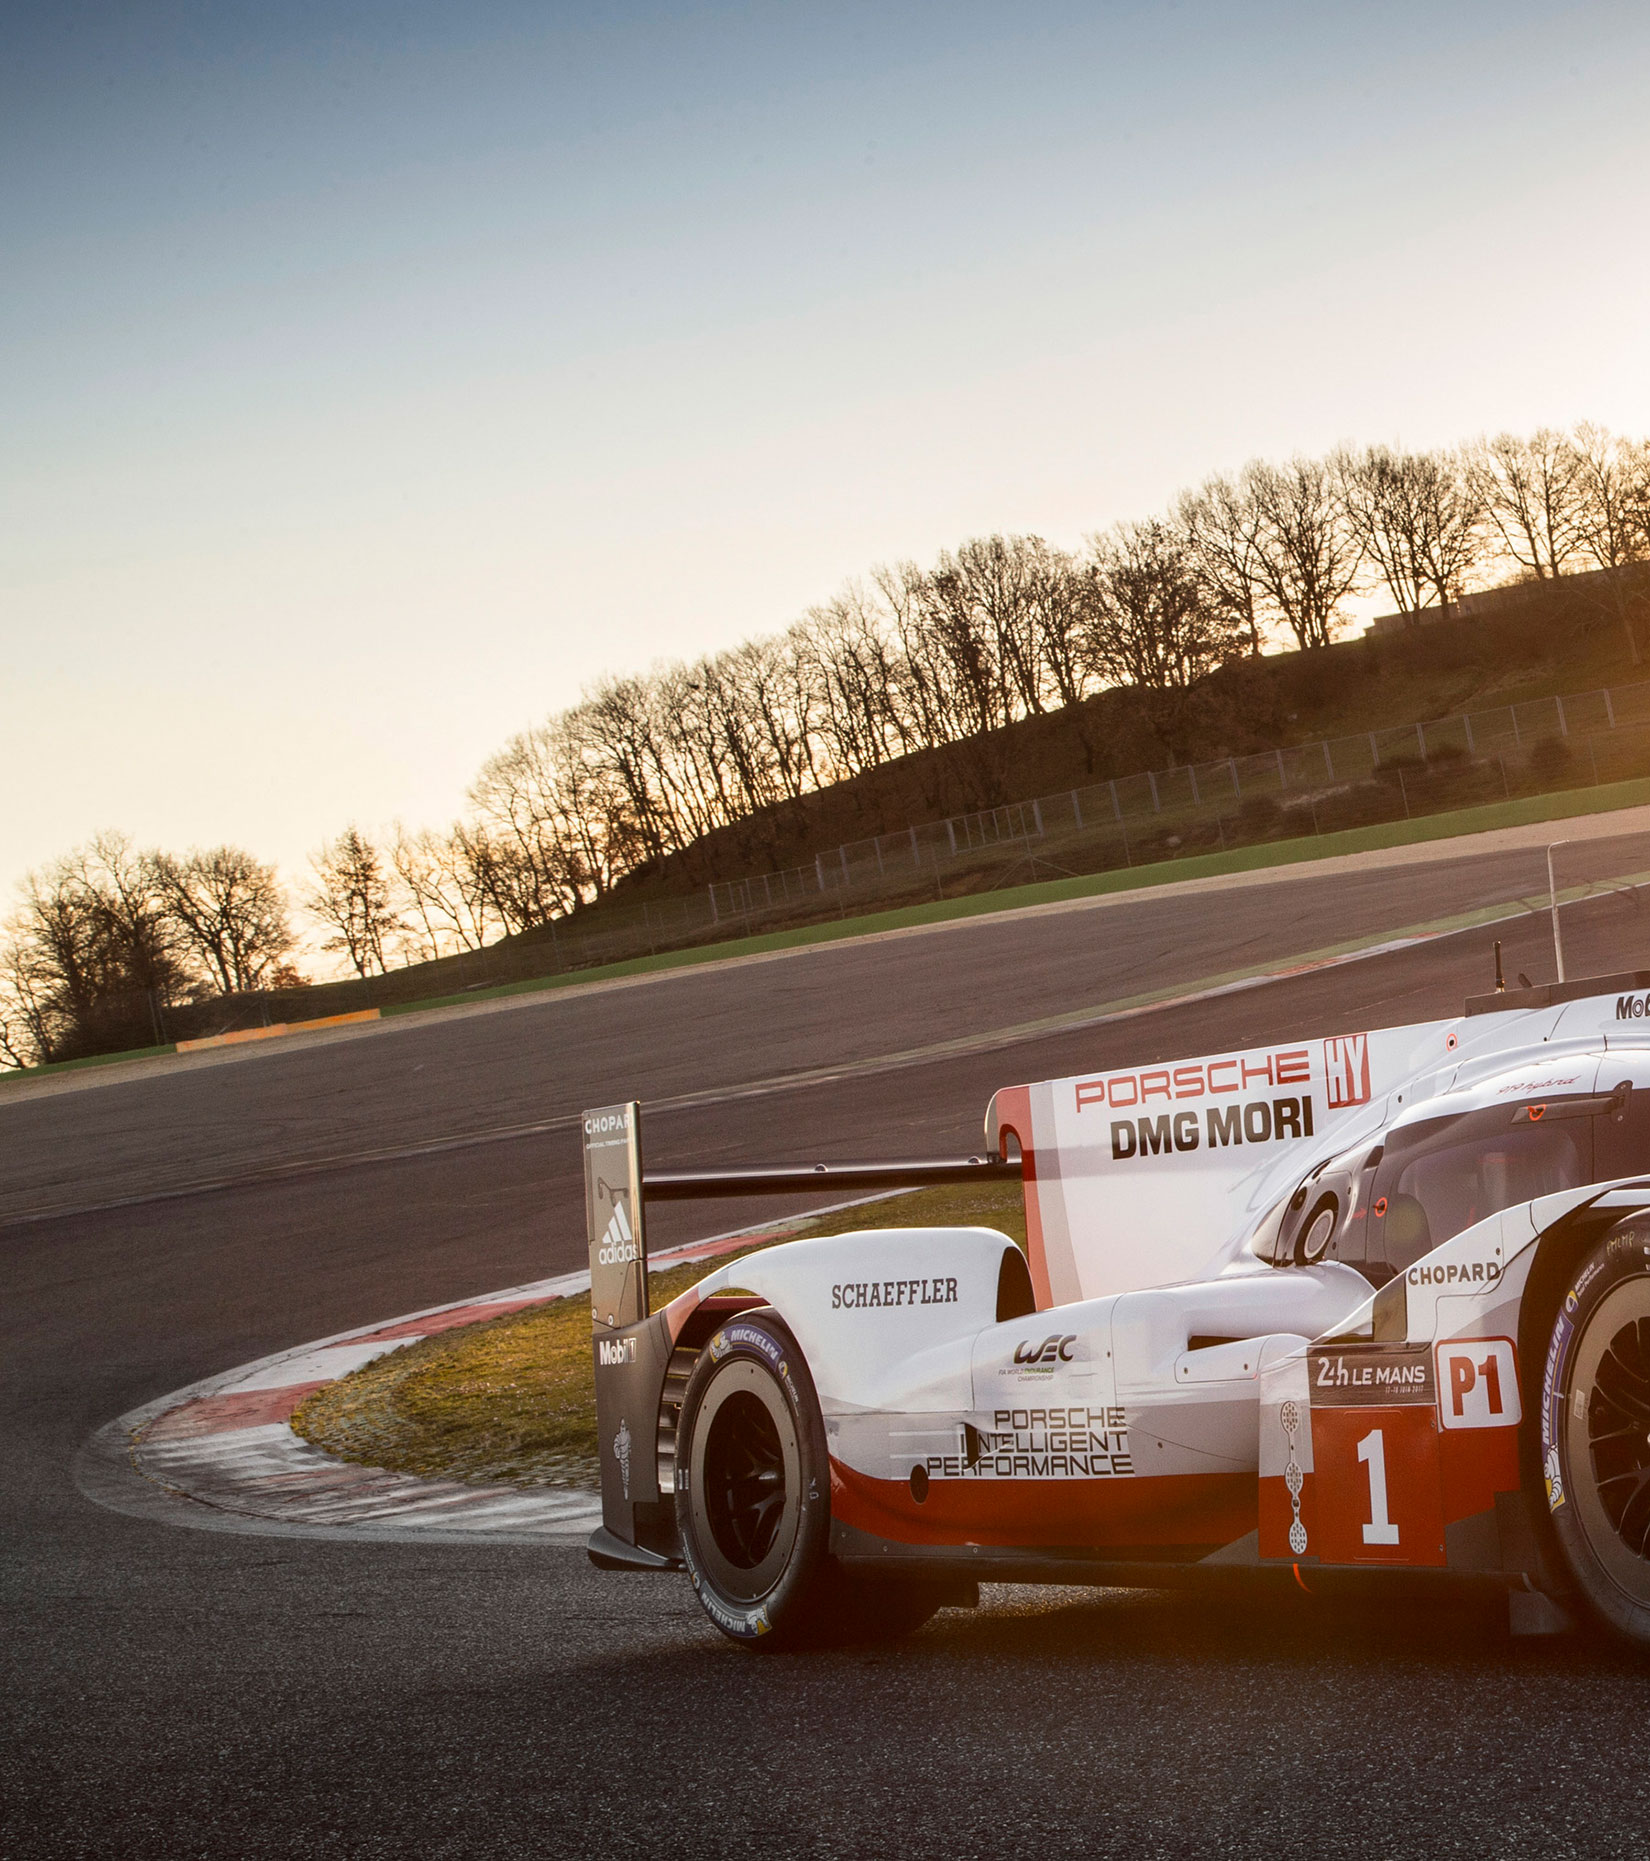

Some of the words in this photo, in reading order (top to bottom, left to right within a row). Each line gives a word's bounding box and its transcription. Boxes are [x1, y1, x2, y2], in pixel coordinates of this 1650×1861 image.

[1075, 1050, 1311, 1113] PORSCHE
[1324, 1033, 1371, 1109] HY
[585, 1113, 630, 1135] CHOPAR
[1110, 1111, 1200, 1160] DMG
[1206, 1095, 1314, 1148] MORI
[599, 1241, 638, 1265] adidas
[1408, 1262, 1500, 1286] CHOPARD
[832, 1277, 958, 1309] SCHAEFFLER
[599, 1338, 628, 1365] Mobil
[730, 1329, 778, 1360] MICHELIN
[1013, 1335, 1077, 1364] WEC
[1352, 1368, 1373, 1385] LE
[1376, 1365, 1426, 1384] MANS
[1449, 1355, 1504, 1416] P1
[1542, 1315, 1565, 1445] MICHELIN
[994, 1406, 1126, 1430] PORSCHE
[960, 1430, 1128, 1453] INTELLIGENT
[926, 1454, 1136, 1477] PERFORMANCE
[1357, 1429, 1400, 1545] 1
[701, 1592, 746, 1633] MICHELIN
